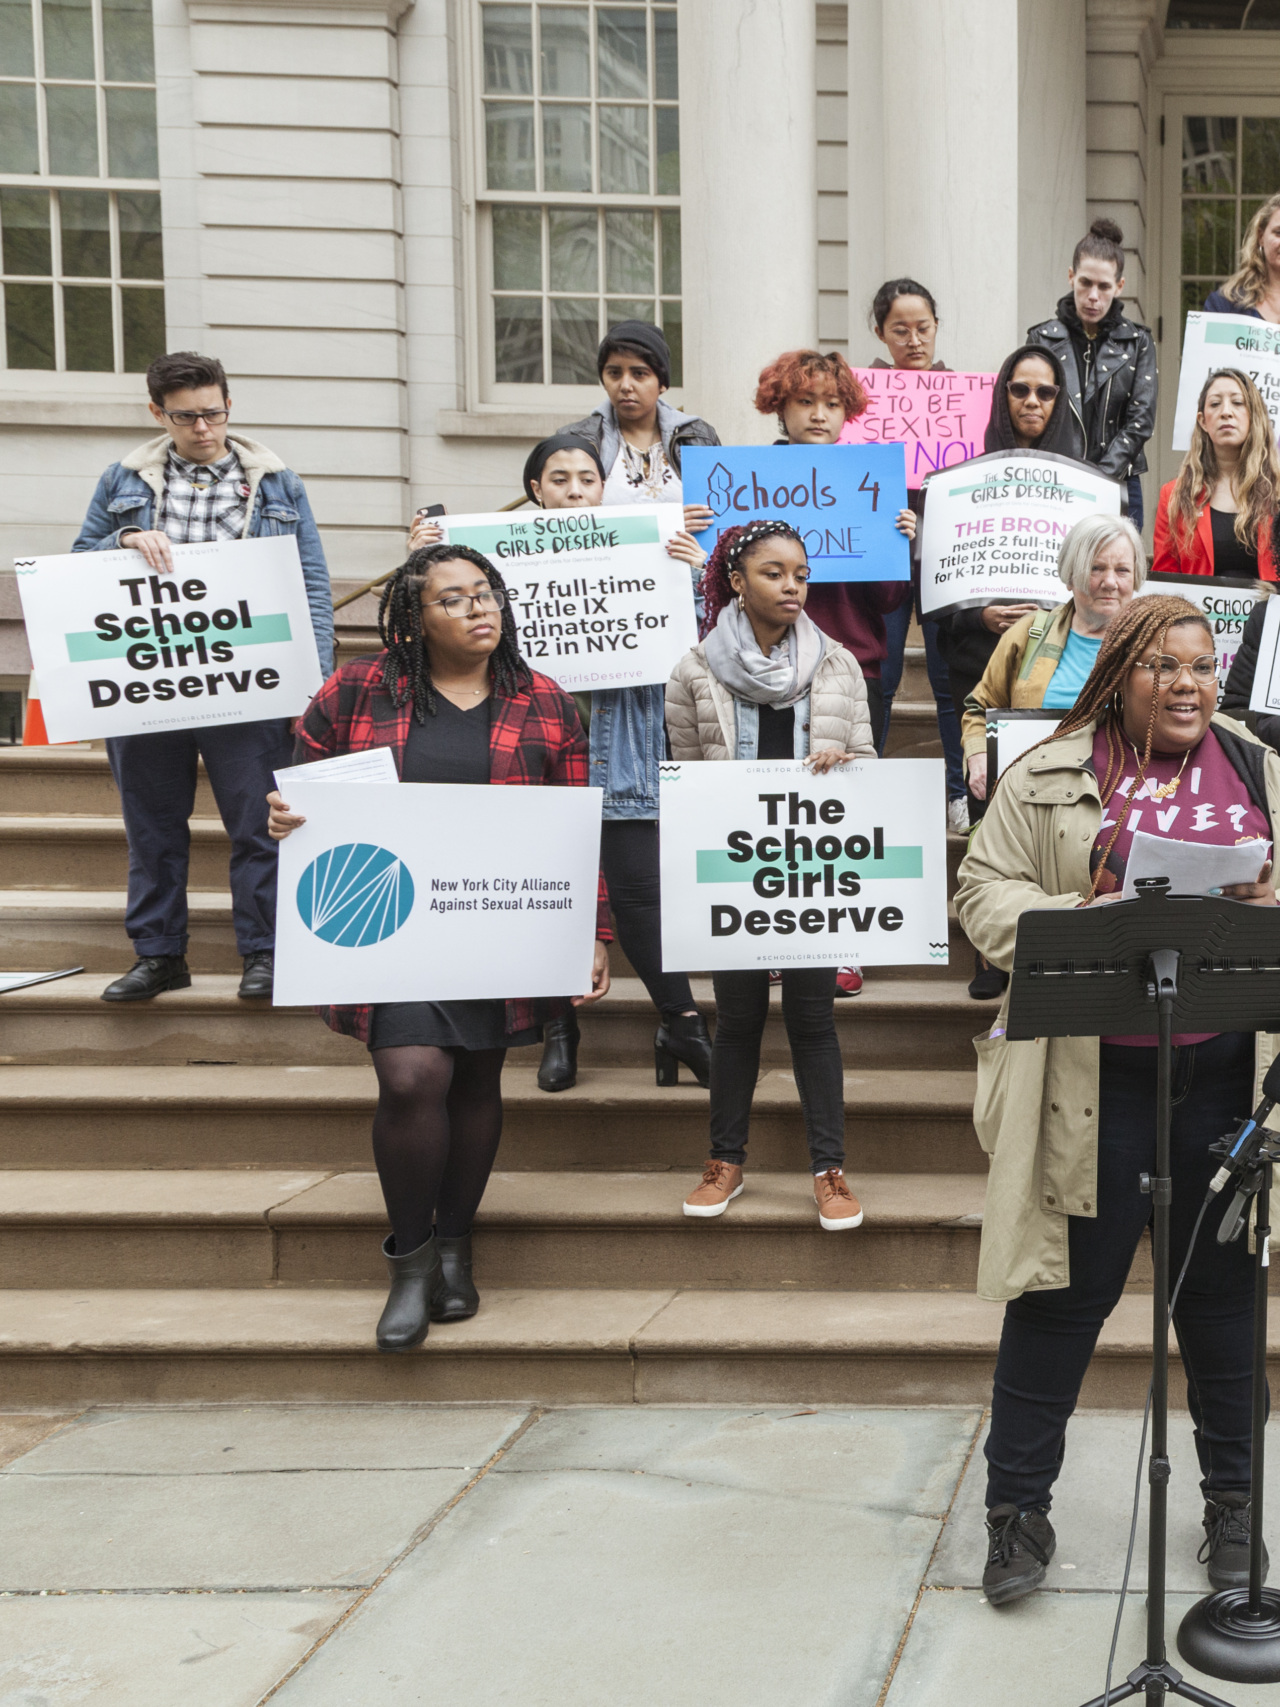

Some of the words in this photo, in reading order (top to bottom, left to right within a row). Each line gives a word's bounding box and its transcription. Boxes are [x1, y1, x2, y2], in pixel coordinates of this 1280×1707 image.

[1236, 337, 1269, 352] GIRLS
[886, 372, 906, 390] IS
[916, 374, 957, 391] NOT
[888, 395, 912, 413] TO
[928, 393, 965, 414] BE
[862, 414, 966, 441] SEXIST
[1004, 467, 1064, 485] SCHOOL
[707, 462, 837, 517] Schools
[858, 472, 880, 511] 4
[972, 485, 1014, 504] GIRLS
[1016, 485, 1074, 503] DESERVE
[507, 524, 528, 536] THE
[534, 514, 605, 535] SCHOOL
[955, 518, 995, 538] THE
[1001, 516, 1070, 538] BRON
[495, 537, 545, 559] GIRLS
[552, 530, 620, 554] DESERVE
[953, 536, 995, 553] needs
[999, 536, 1008, 546] 2
[939, 554, 969, 569] Title
[972, 550, 987, 562] IX
[935, 571, 957, 584] for
[956, 565, 984, 579] K-12
[989, 563, 1039, 576] public
[119, 575, 207, 606] The
[525, 583, 540, 600] 7
[547, 576, 656, 598] full-time
[970, 586, 1057, 596] #SchoolGirlsDeserve
[519, 597, 576, 619] Title
[584, 597, 609, 615] IX
[94, 600, 253, 642] School
[635, 612, 669, 630] for
[126, 635, 234, 671] Girls
[556, 635, 579, 655] in
[586, 632, 638, 653] NYC
[88, 667, 280, 709] Deserve
[142, 710, 243, 726] #SCHOOLGIRLSDESERVE
[758, 792, 845, 825] The
[727, 827, 884, 863] School
[432, 879, 458, 892] New
[462, 878, 489, 892] York
[493, 878, 518, 894] City
[521, 878, 570, 892] Alliance
[752, 861, 861, 899] Girls
[430, 898, 477, 913] Against
[482, 897, 523, 910] Sexual
[527, 897, 573, 910] Assault
[711, 905, 904, 937] Deserve
[757, 953, 860, 961] #SCHOOLGIRLSDESERVE
